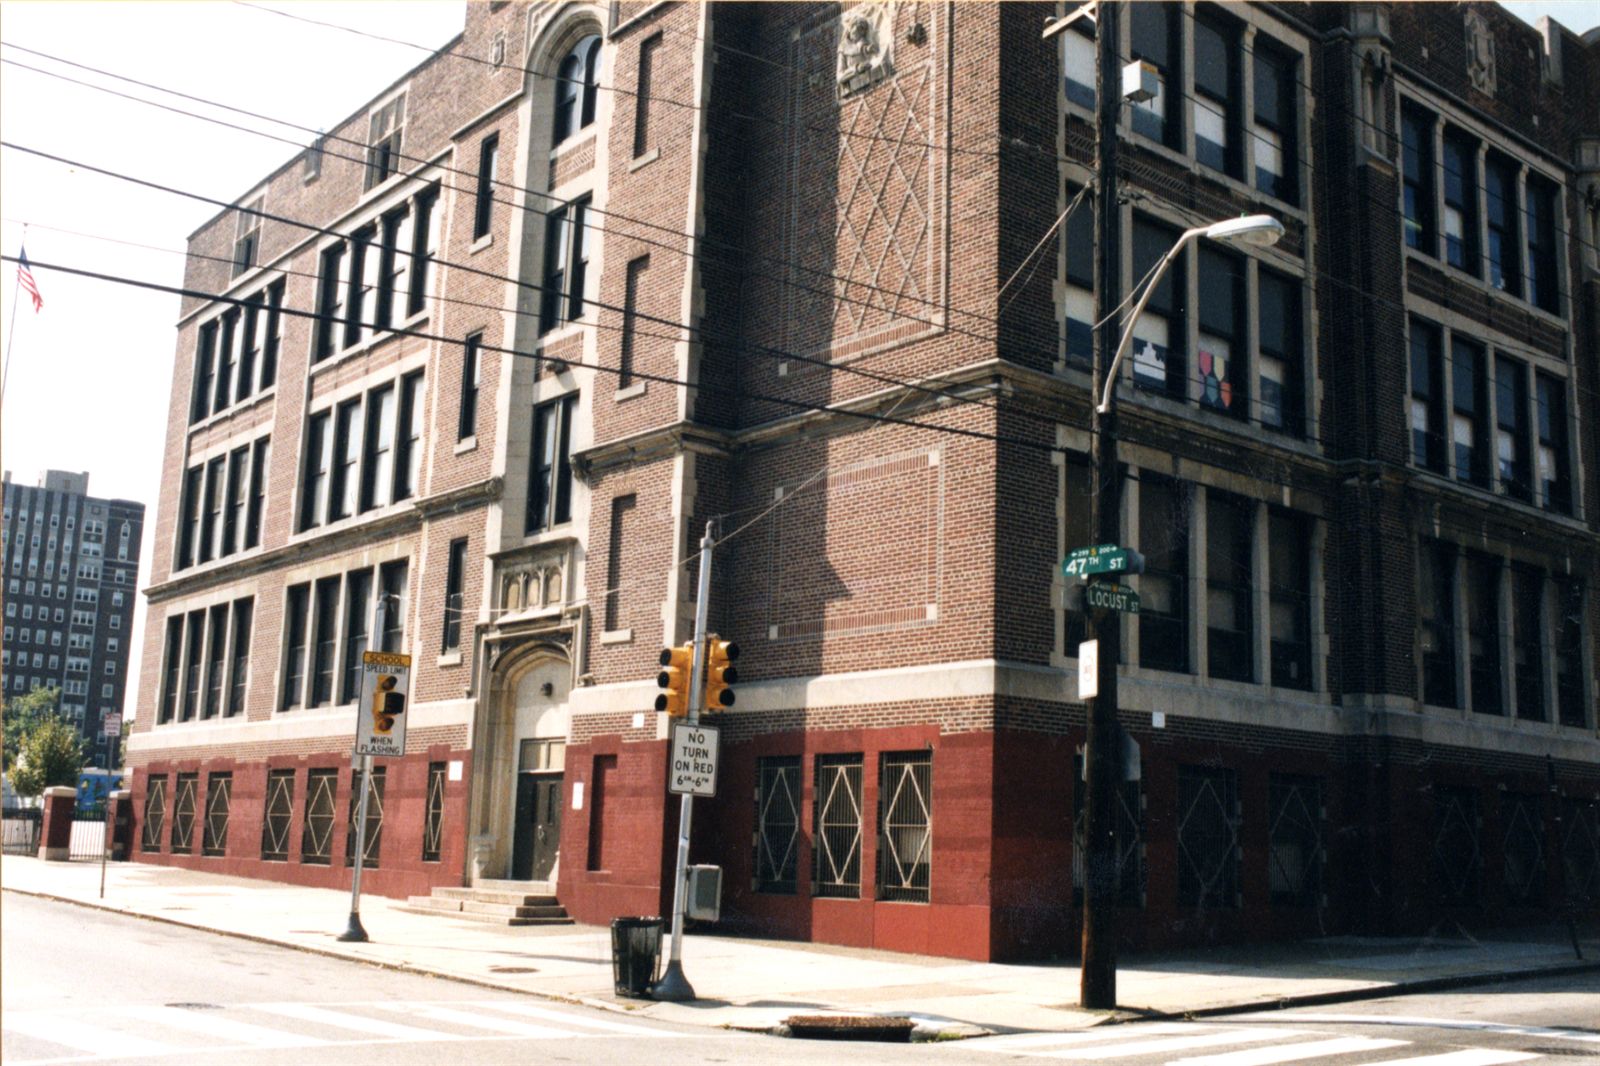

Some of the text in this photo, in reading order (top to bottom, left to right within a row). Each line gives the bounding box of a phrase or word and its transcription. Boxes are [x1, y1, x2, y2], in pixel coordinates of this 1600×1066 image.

[1066, 557, 1123, 574] 47TH ST
[1089, 590, 1139, 612] LOCUST ST
[369, 654, 403, 665] SCHOOL
[366, 664, 406, 675] SPEED LIMIT
[370, 736, 393, 746] WHEN
[688, 733, 705, 744] NO
[361, 745, 400, 754] FLASHING
[682, 746, 709, 759] TURN
[675, 760, 713, 774] ON RED
